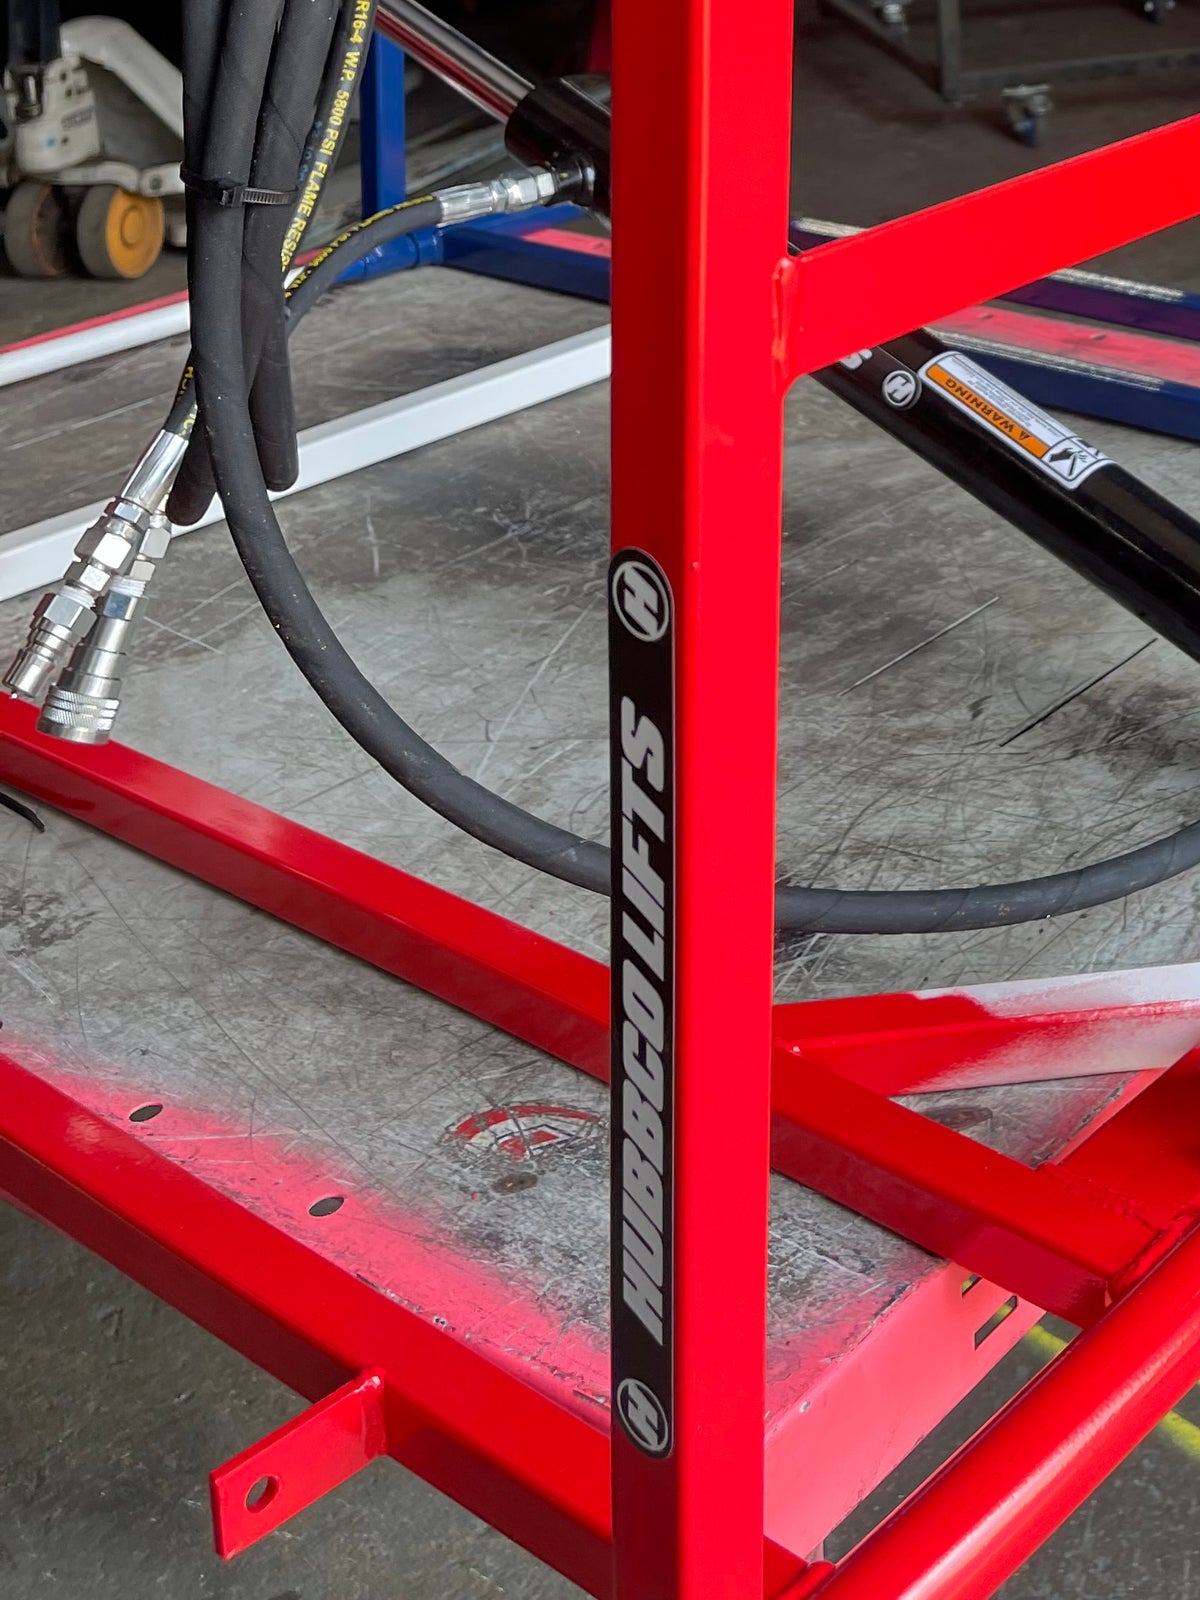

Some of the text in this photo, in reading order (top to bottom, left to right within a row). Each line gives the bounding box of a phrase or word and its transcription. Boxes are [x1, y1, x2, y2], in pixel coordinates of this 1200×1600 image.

[340, 51, 360, 81] W.P.
[328, 89, 349, 126] 5800
[320, 127, 339, 157] PSI
[297, 161, 328, 218] FLAME
[945, 378, 1016, 433] WARNING
